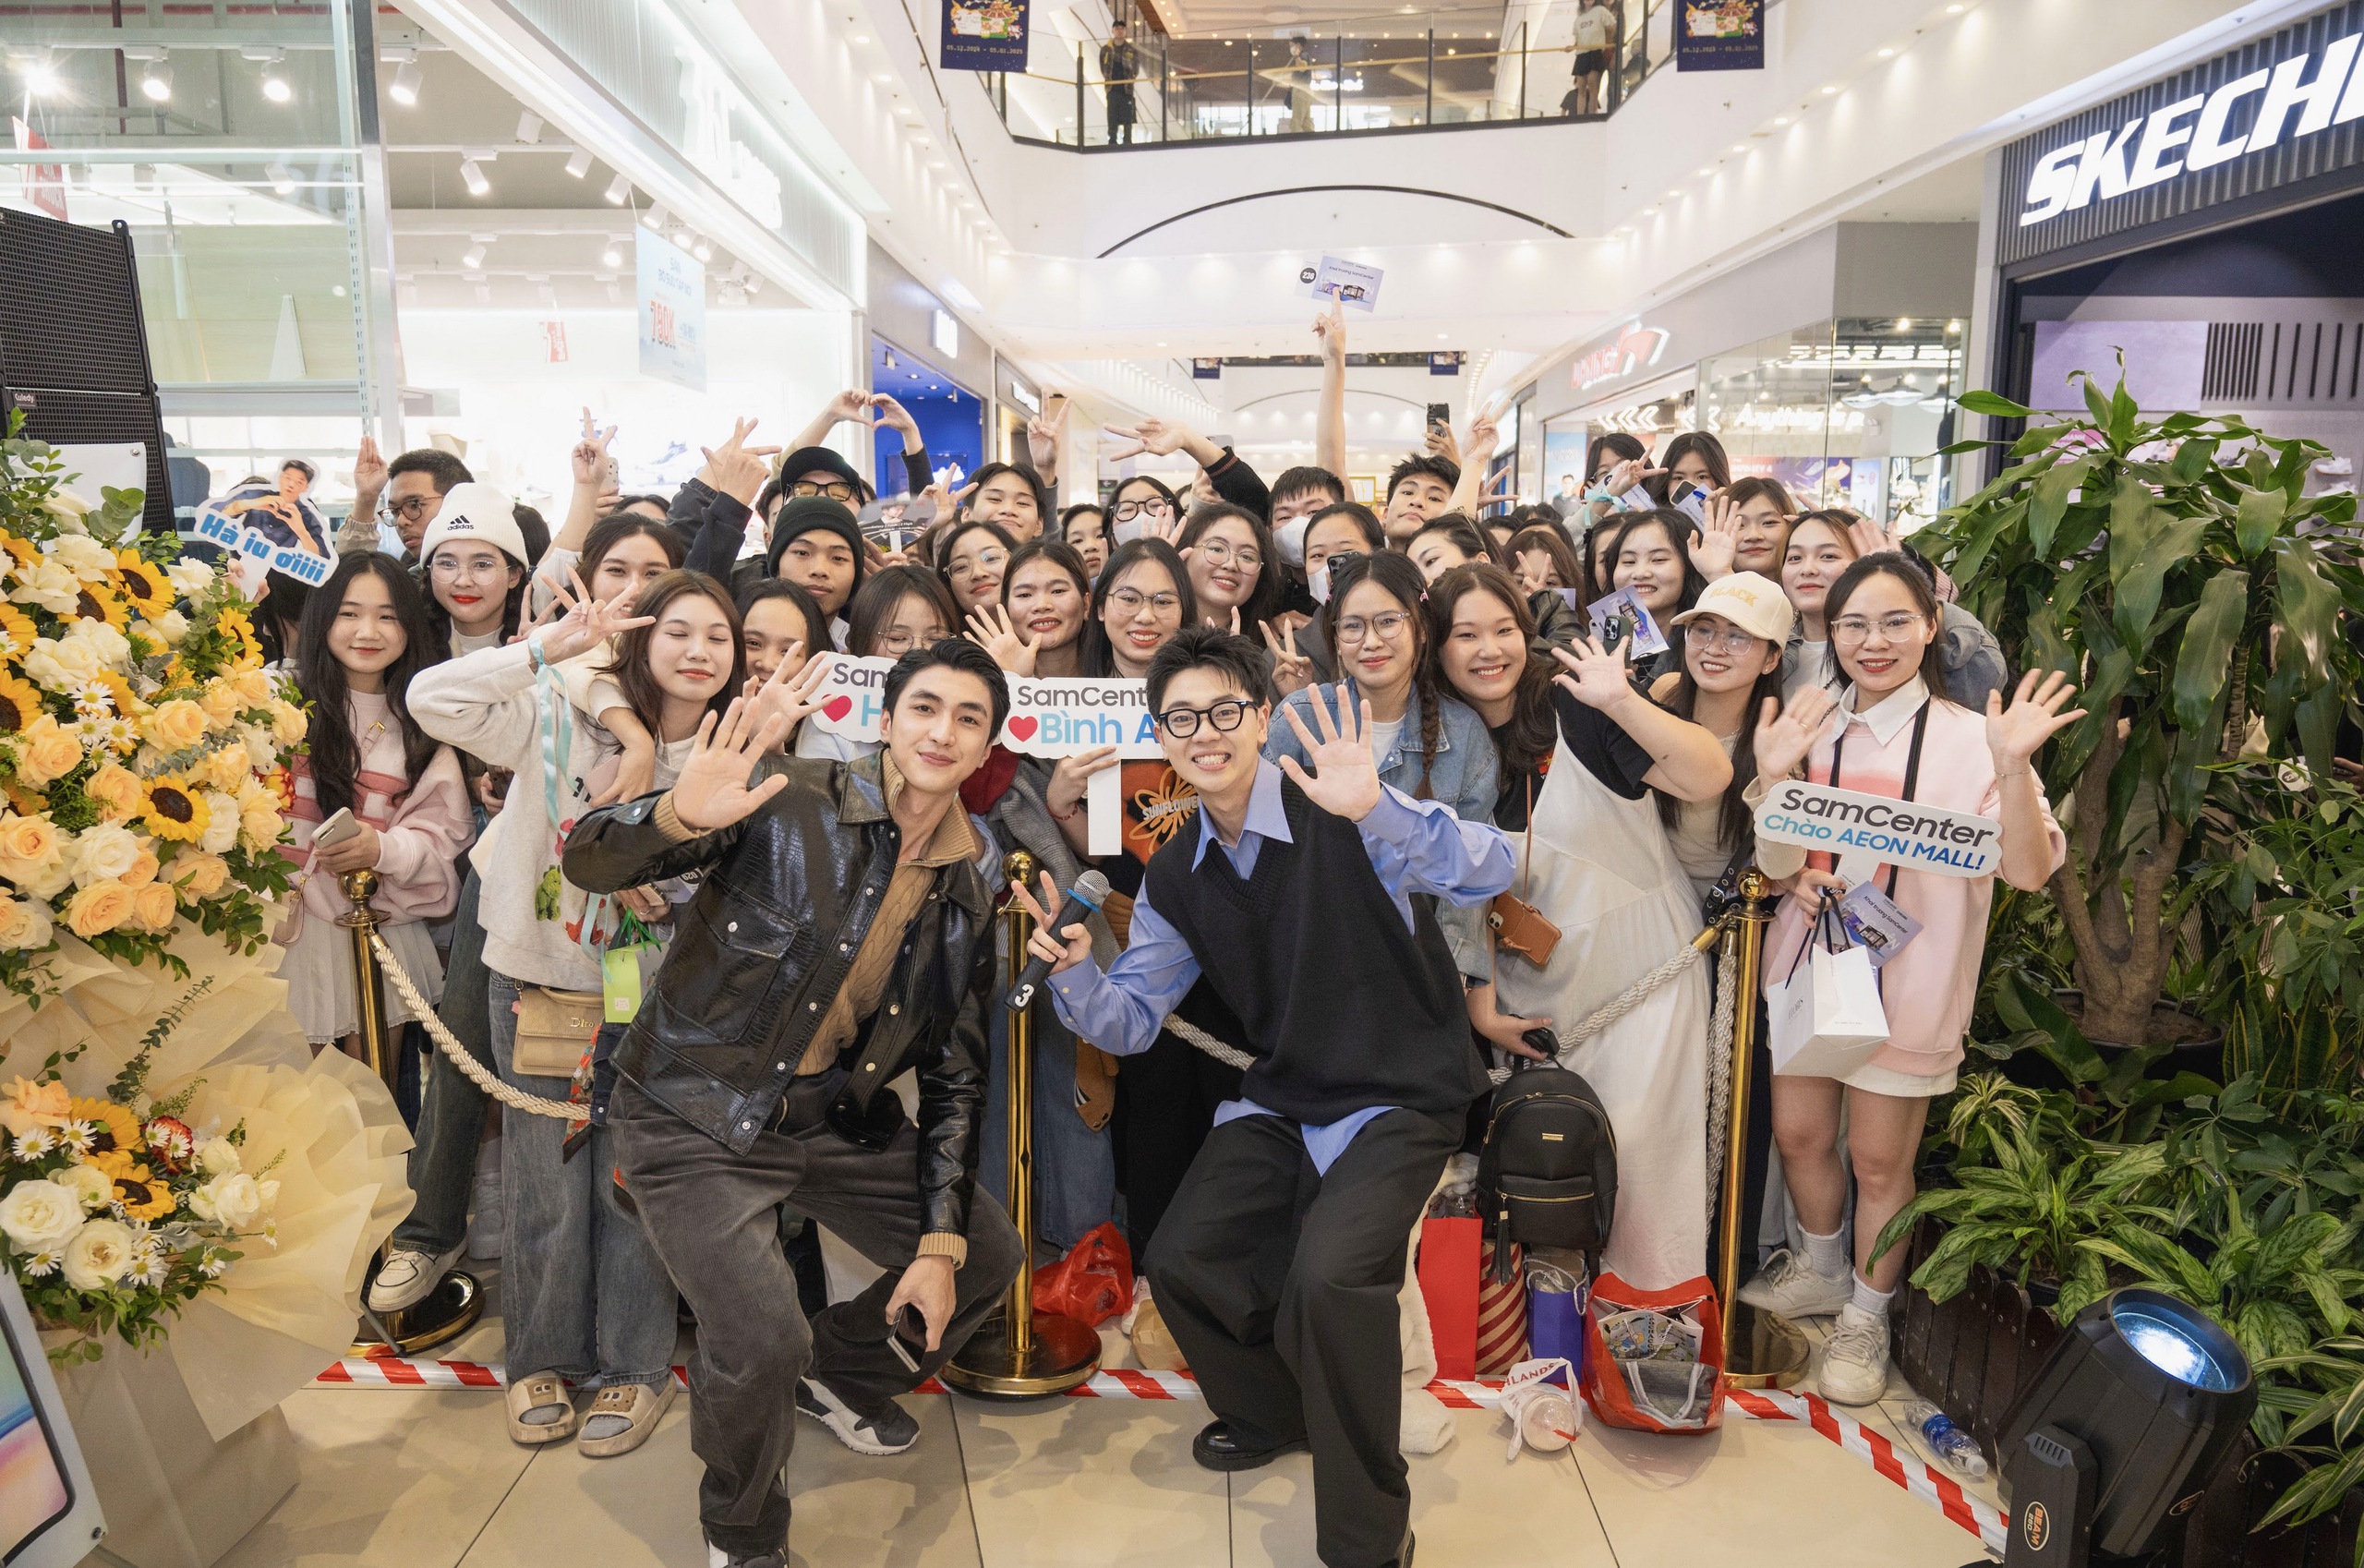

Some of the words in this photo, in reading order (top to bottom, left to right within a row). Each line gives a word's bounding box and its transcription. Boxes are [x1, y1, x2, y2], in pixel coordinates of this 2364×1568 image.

[200, 513, 239, 545] Hà
[243, 532, 271, 560] iu
[1041, 710, 1122, 744] Bình
[1780, 789, 1994, 847] SamCenter
[1764, 814, 1832, 839] Chào
[1837, 827, 1911, 855] AEON
[1912, 842, 1985, 870] MALL!
[1015, 983, 1034, 1007] 3
[2032, 1506, 2044, 1546] BEAM
